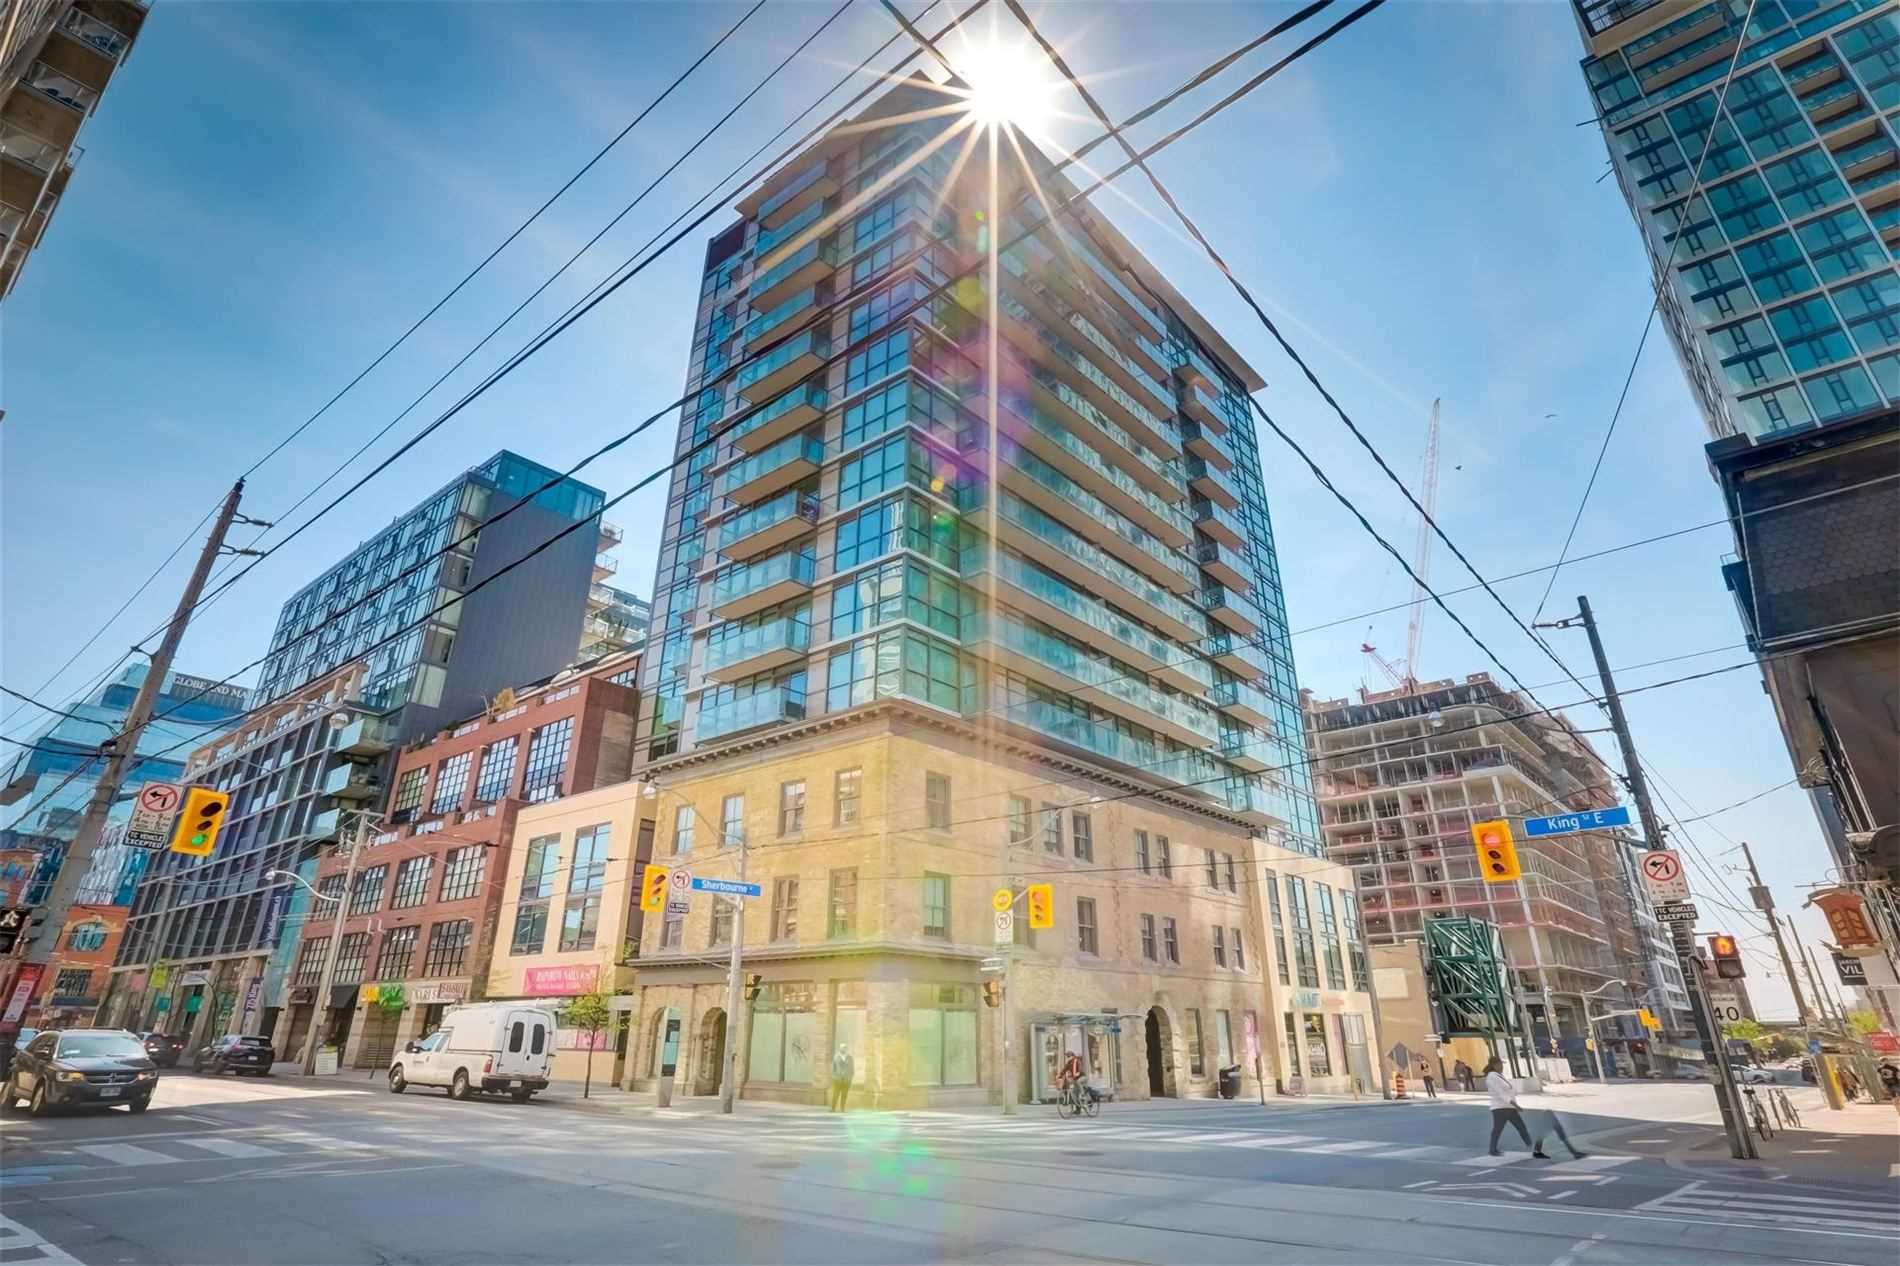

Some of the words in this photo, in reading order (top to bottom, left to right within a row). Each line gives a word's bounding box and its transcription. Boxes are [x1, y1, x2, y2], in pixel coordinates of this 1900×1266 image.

[175, 675, 206, 691] GLOBE
[208, 683, 230, 695] AND
[1547, 817, 1580, 831] King
[1594, 812, 1604, 824] E
[701, 880, 748, 893] Sherbourne
[1657, 912, 1697, 922] EXCEPTED
[1714, 1006, 1739, 1021] 40
